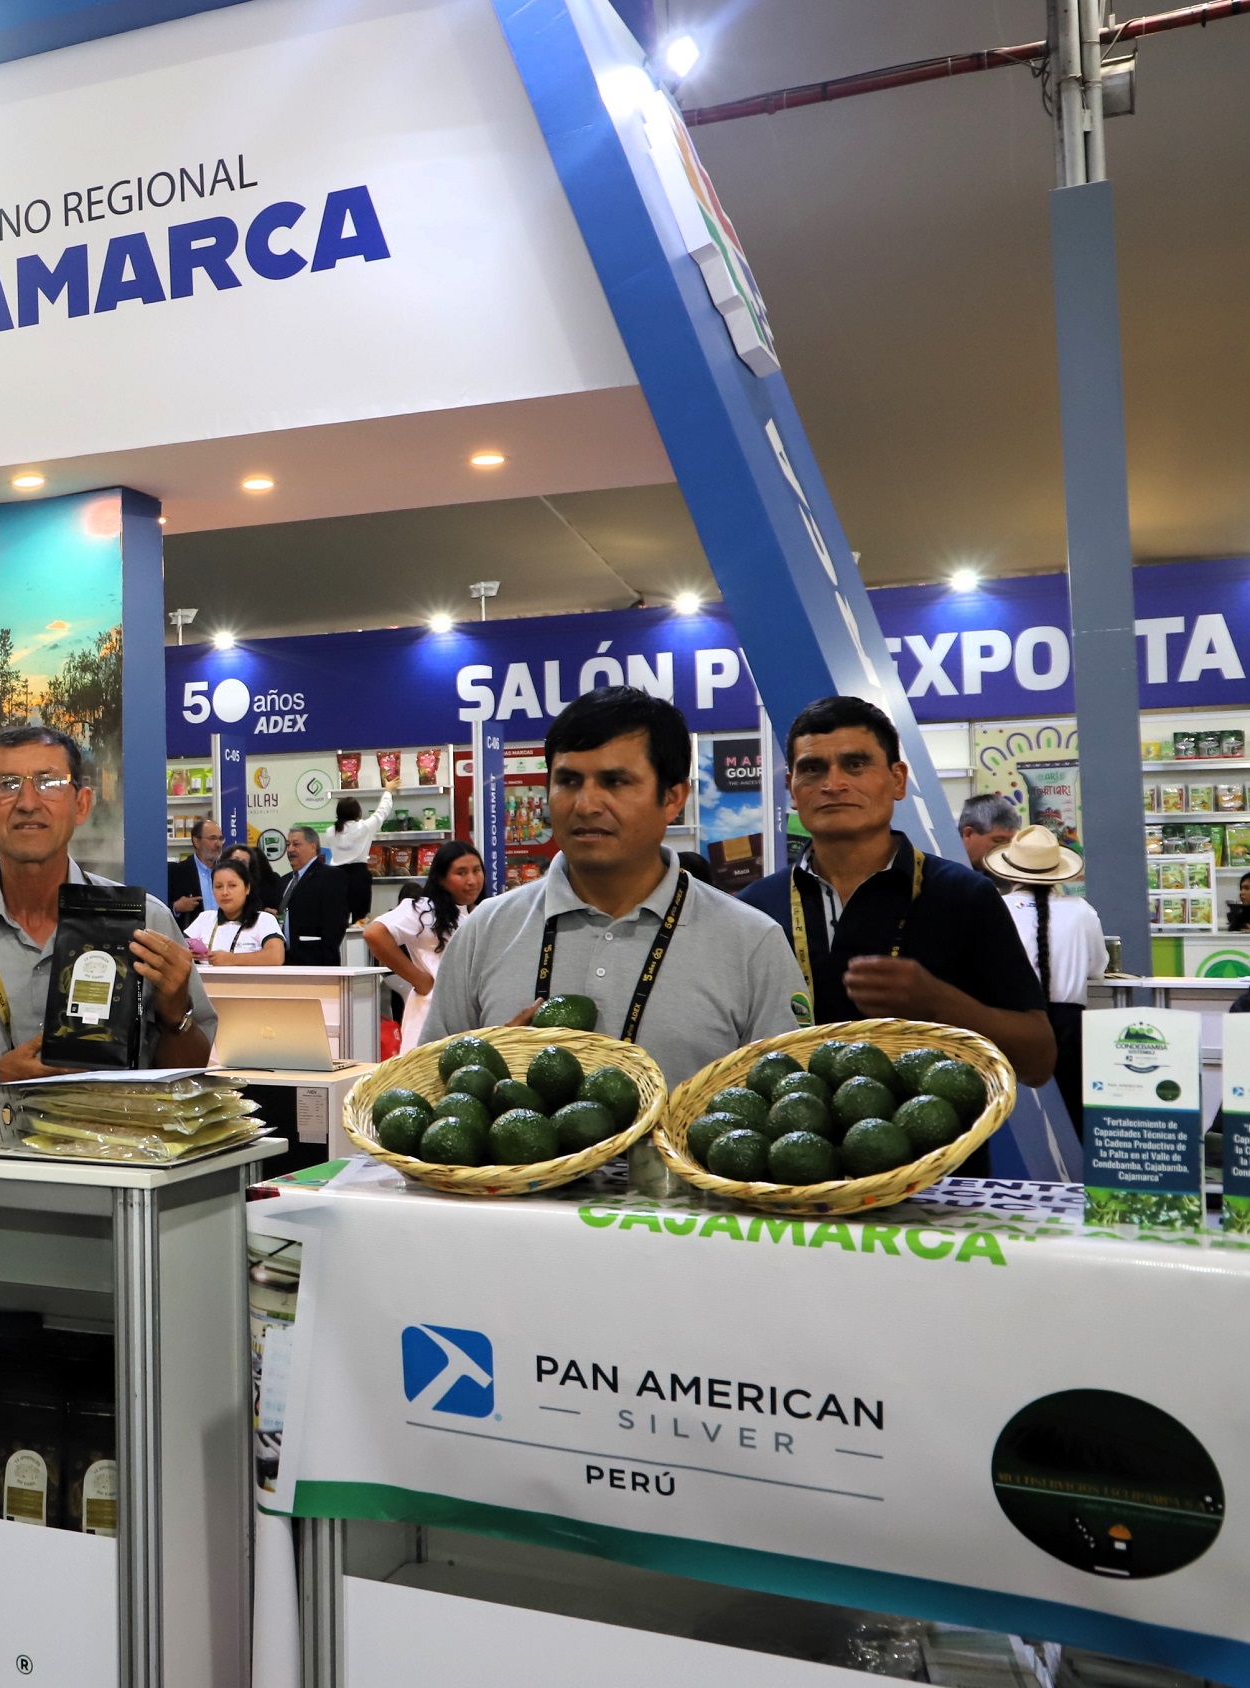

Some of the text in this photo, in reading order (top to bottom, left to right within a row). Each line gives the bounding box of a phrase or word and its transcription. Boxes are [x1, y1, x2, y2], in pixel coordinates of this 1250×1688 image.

[61, 152, 260, 225] REGIONAL
[456, 641, 675, 722] SALÓN
[884, 612, 1248, 698] XPOTA
[252, 688, 305, 713] años
[254, 714, 309, 734] ADEX
[486, 735, 500, 750] C-06
[224, 748, 240, 762] C-05
[247, 793, 279, 808] LILAY
[490, 774, 499, 846] GOURMET
[631, 1003, 642, 1022] ADEX
[1115, 1043, 1168, 1051] CONDEBAMBA
[1103, 1117, 1178, 1130] "Fortalecimiento de
[1093, 1127, 1188, 1141] Capacidades Técnicas de
[1095, 1138, 1186, 1151] la Cadena Productiva de
[1100, 1149, 1107, 1157] la
[1109, 1149, 1129, 1159] Palta
[1142, 1152, 1149, 1160] el
[1151, 1152, 1171, 1161] Valle
[1172, 1153, 1182, 1162] de
[1118, 1171, 1163, 1182] Cajamarca"
[535, 1355, 884, 1430] PAN AMERICAN
[618, 1409, 795, 1455] SILVER
[586, 1464, 676, 1497] PERÚ
